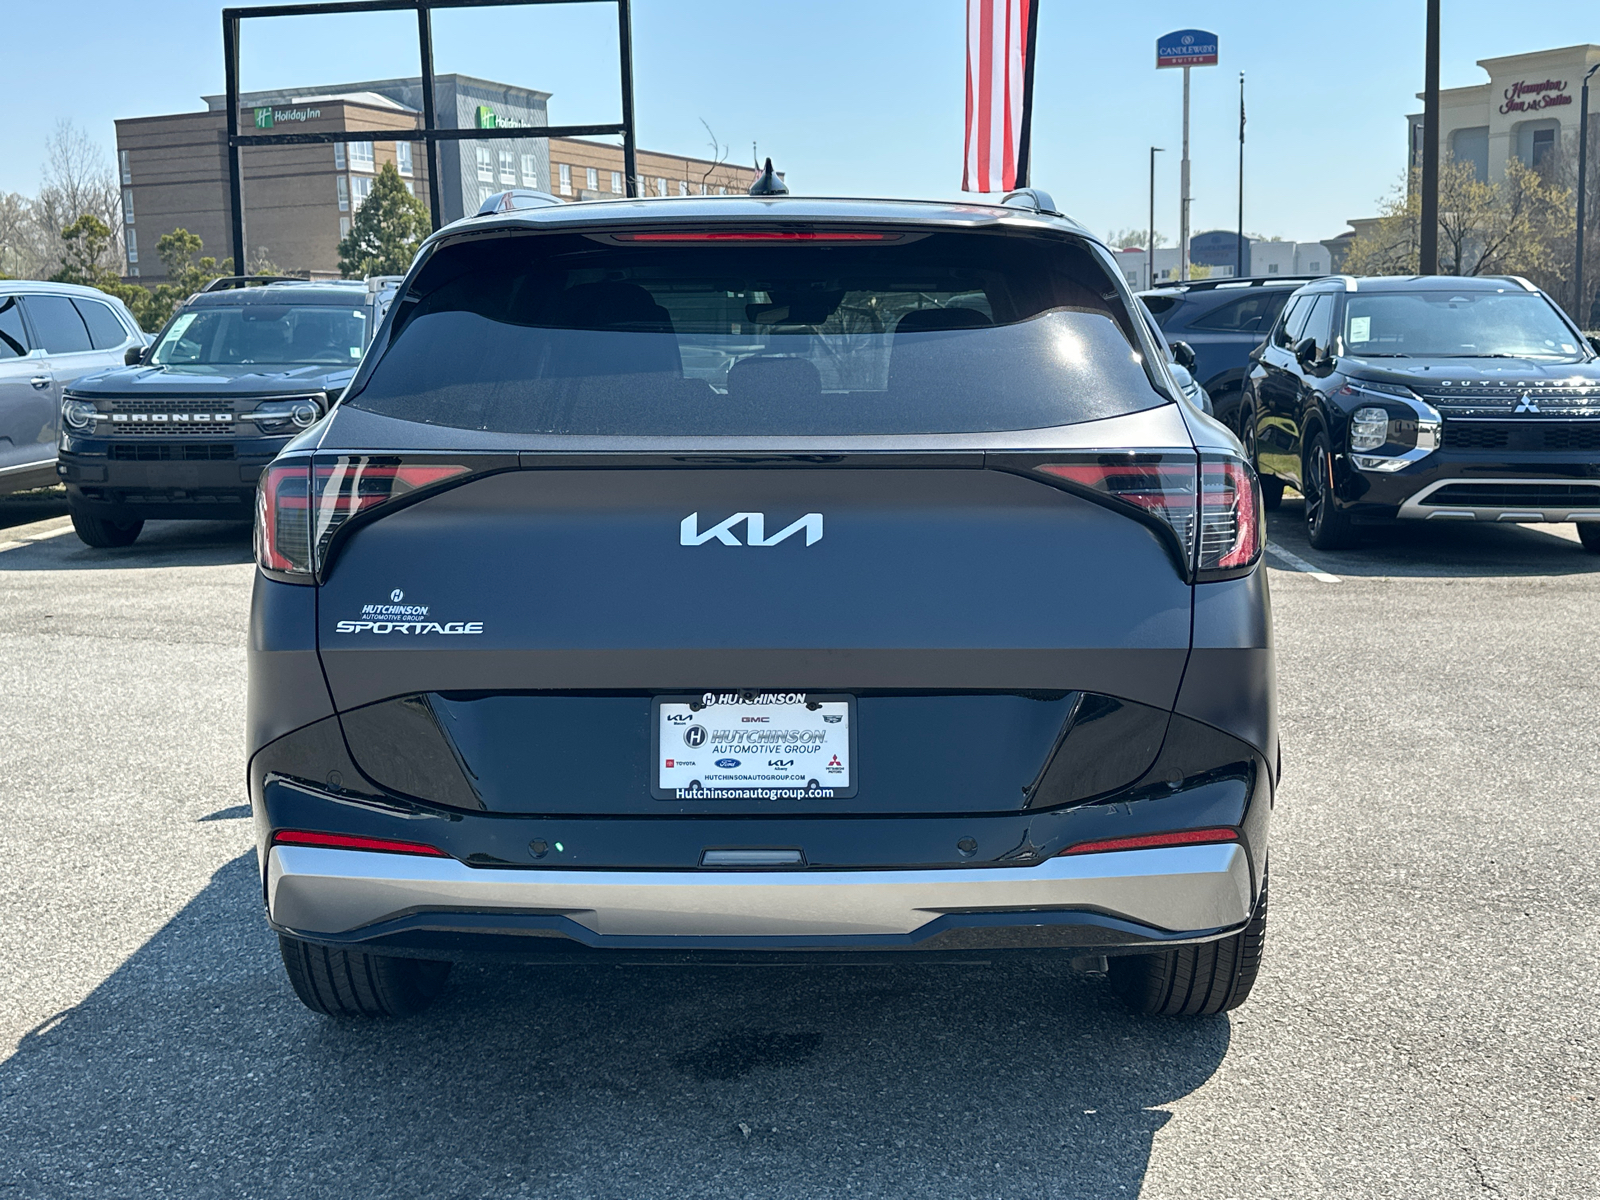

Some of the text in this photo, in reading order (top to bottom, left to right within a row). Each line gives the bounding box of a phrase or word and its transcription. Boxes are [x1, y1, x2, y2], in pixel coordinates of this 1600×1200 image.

[1160, 45, 1216, 55] CANDLEWOOD
[1504, 80, 1567, 100] Hampton
[1499, 99, 1530, 114] Inn
[1538, 94, 1572, 109] Suites
[275, 107, 321, 122] Holiday Inn
[112, 413, 232, 421] BRONCO
[680, 511, 823, 547] KIA
[361, 604, 429, 615] HUTCHINSON
[335, 620, 484, 635] SPORTAGE
[710, 729, 826, 744] HUTCHINSON
[712, 745, 821, 754] AUTOMOTIVE GROUP
[719, 760, 737, 768] Ford
[768, 759, 794, 767] KIA
[676, 787, 834, 800] Hutchinsonautogroup.com
